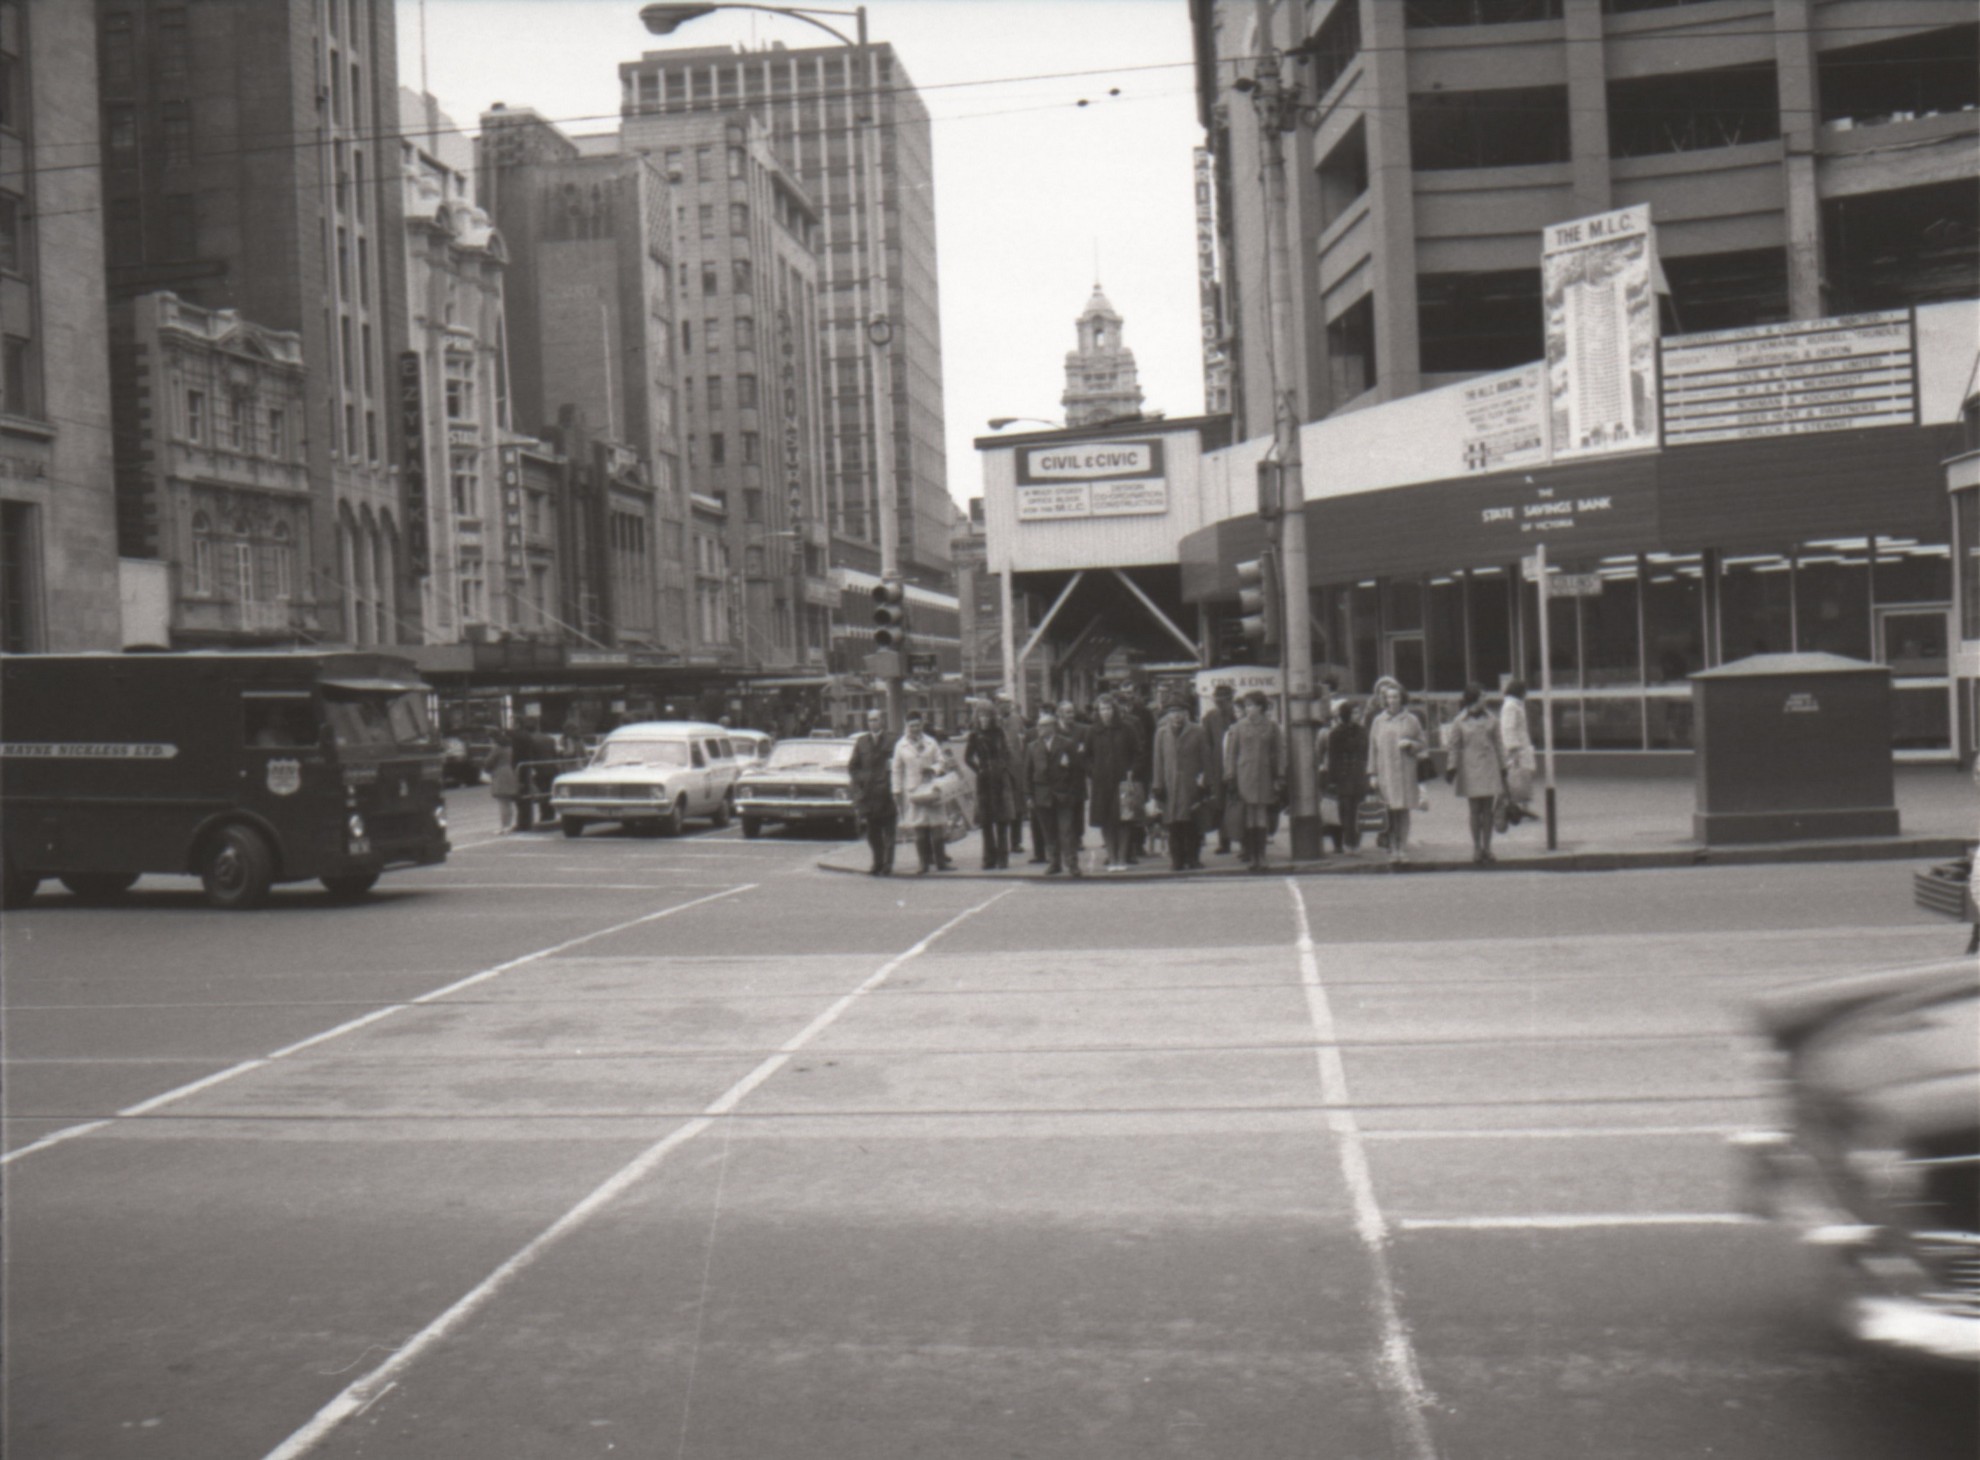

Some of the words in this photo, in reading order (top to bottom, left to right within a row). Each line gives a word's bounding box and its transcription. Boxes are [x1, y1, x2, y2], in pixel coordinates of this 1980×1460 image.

[1556, 225, 1582, 245] THE
[1589, 214, 1634, 237] M.L.C.
[1820, 403, 1877, 416] PARTNERS
[1803, 419, 1853, 432] STEWART
[1041, 455, 1081, 470] CIVIL
[1096, 451, 1138, 467] CIVIC
[1482, 507, 1514, 522] STATE
[1523, 500, 1573, 517] SAVINGS
[1577, 496, 1612, 512] BANK
[2, 744, 52, 756] MAYNE
[57, 744, 129, 756] NICKLESS
